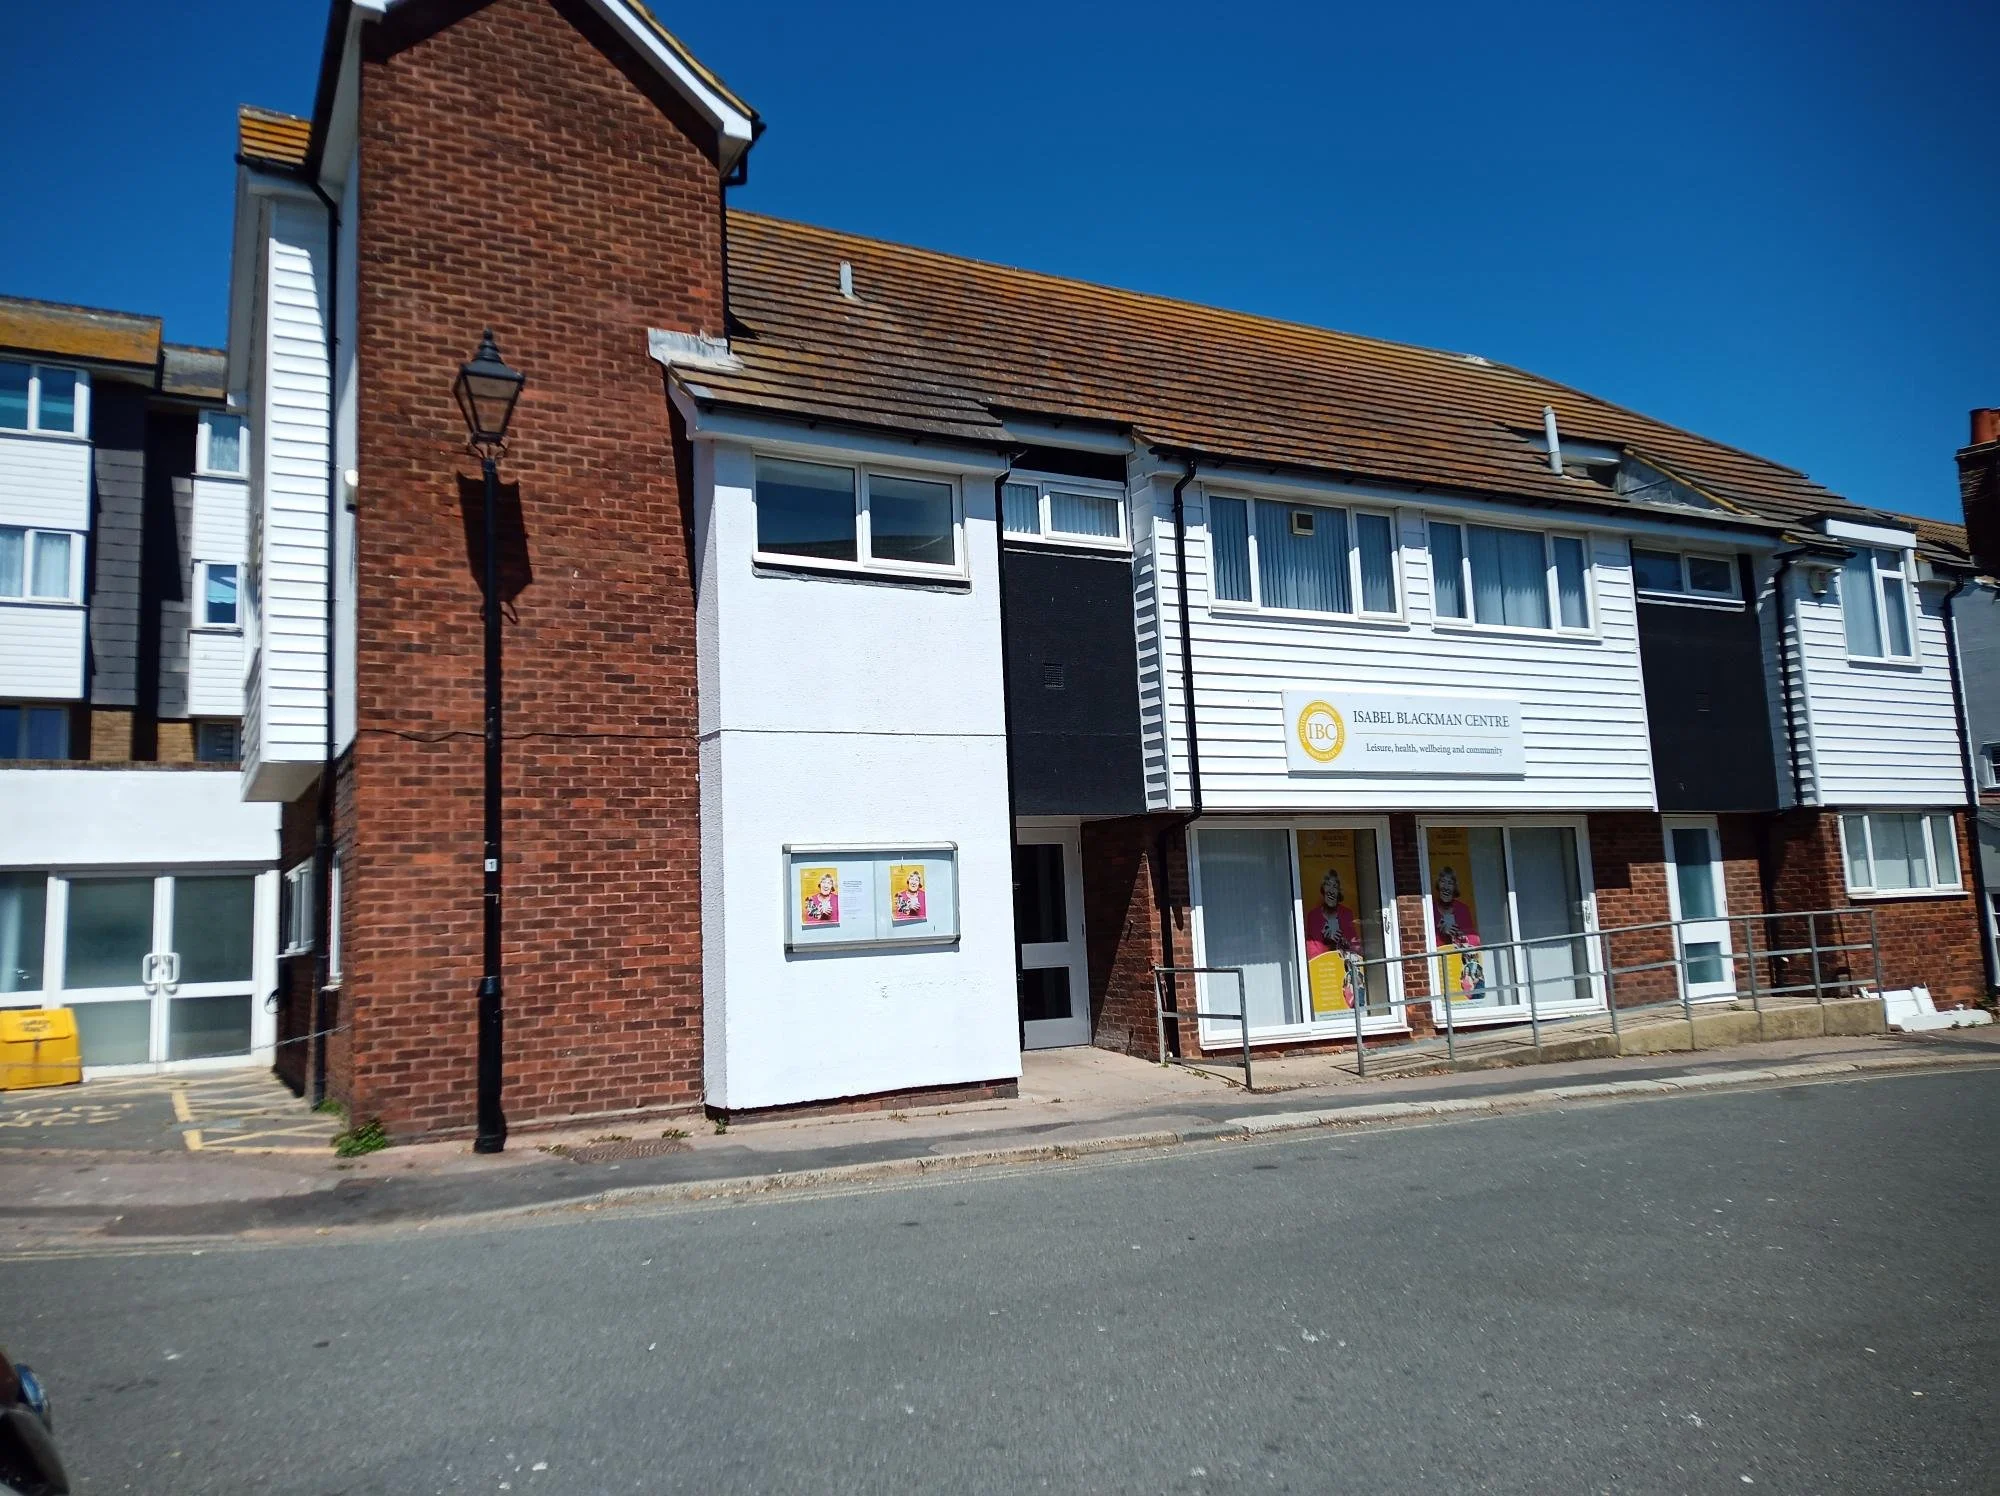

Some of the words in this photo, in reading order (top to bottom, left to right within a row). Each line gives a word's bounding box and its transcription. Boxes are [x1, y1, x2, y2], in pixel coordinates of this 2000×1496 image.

[1353, 710, 1394, 724] ISABEL
[1397, 712, 1462, 726] BLACKMAN
[1465, 714, 1510, 727] CENTRE
[1308, 722, 1336, 741] IBC
[1366, 743, 1393, 753] Leisure,
[1395, 744, 1418, 754] health,
[1419, 744, 1451, 756] wellbeing
[1452, 746, 1465, 754] and
[1466, 746, 1502, 756] community
